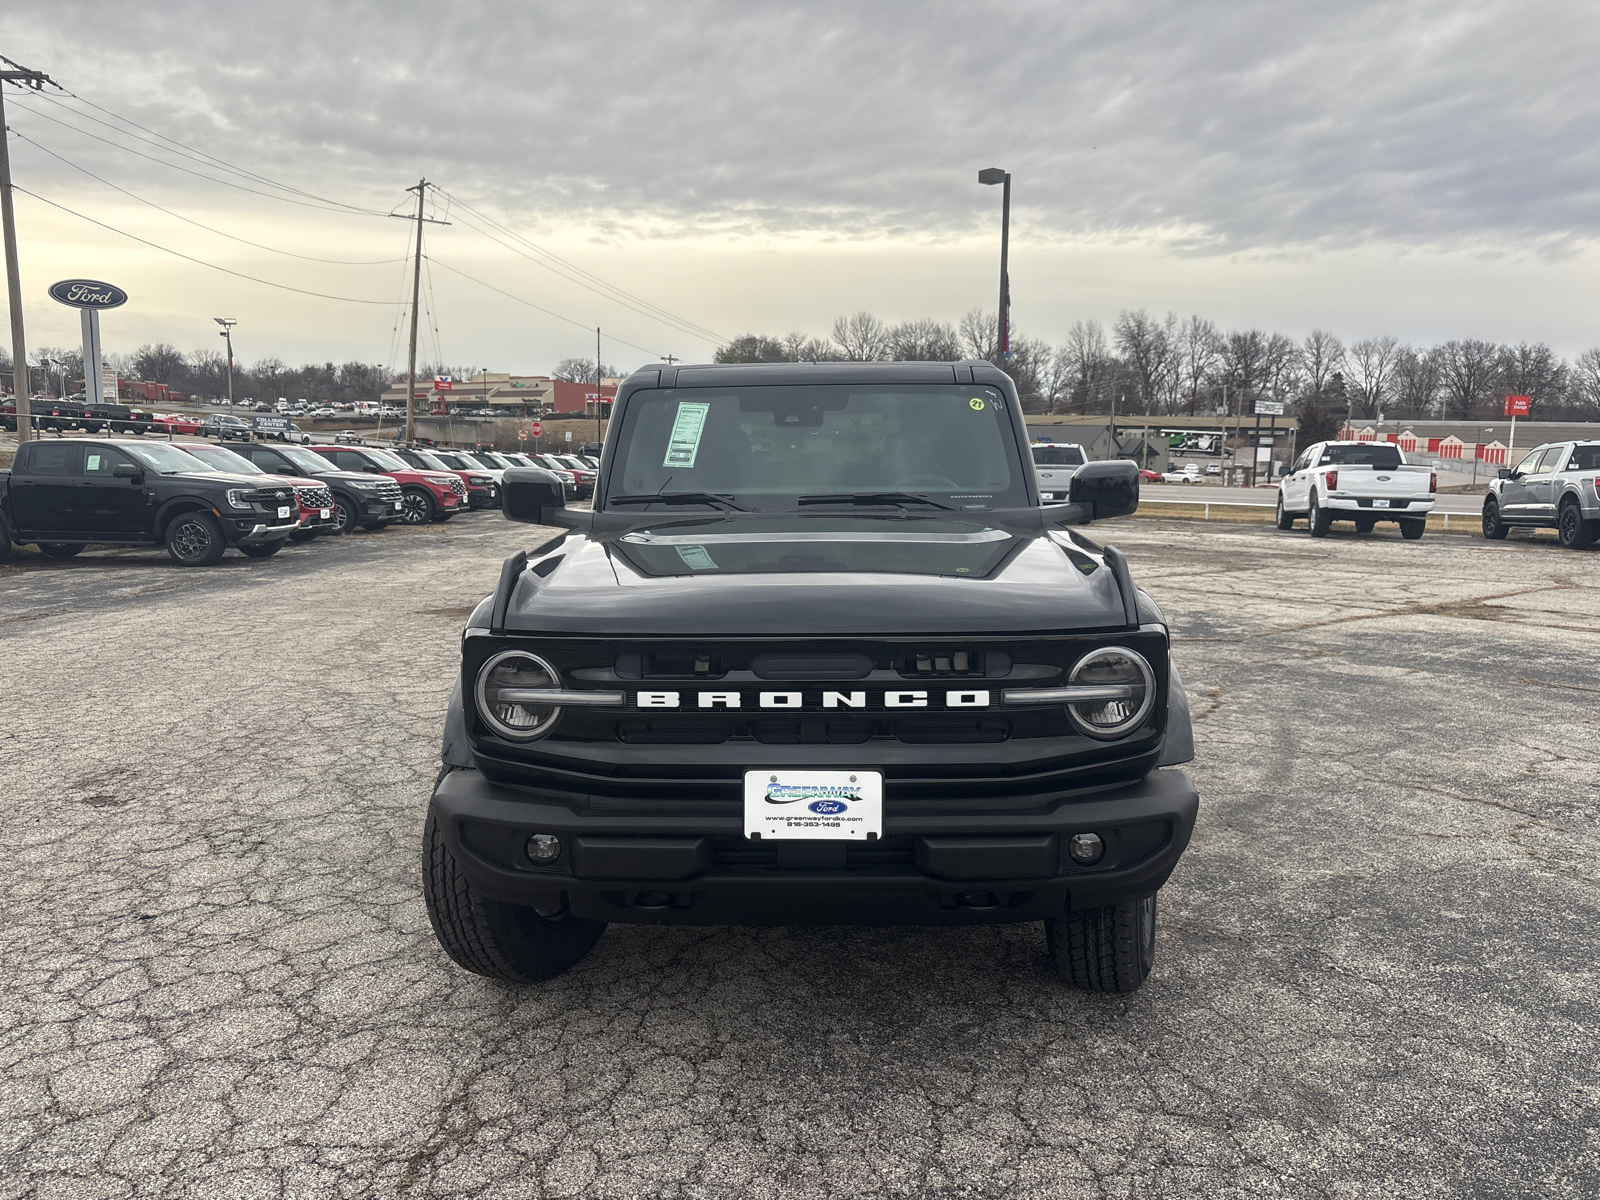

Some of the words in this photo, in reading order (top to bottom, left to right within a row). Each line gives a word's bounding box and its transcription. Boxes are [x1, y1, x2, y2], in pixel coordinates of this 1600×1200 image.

[67, 284, 112, 304] Ford
[971, 400, 983, 409] 21
[636, 690, 990, 708] BRONCO
[767, 783, 862, 798] GREENWAY
[816, 801, 840, 813] Ford
